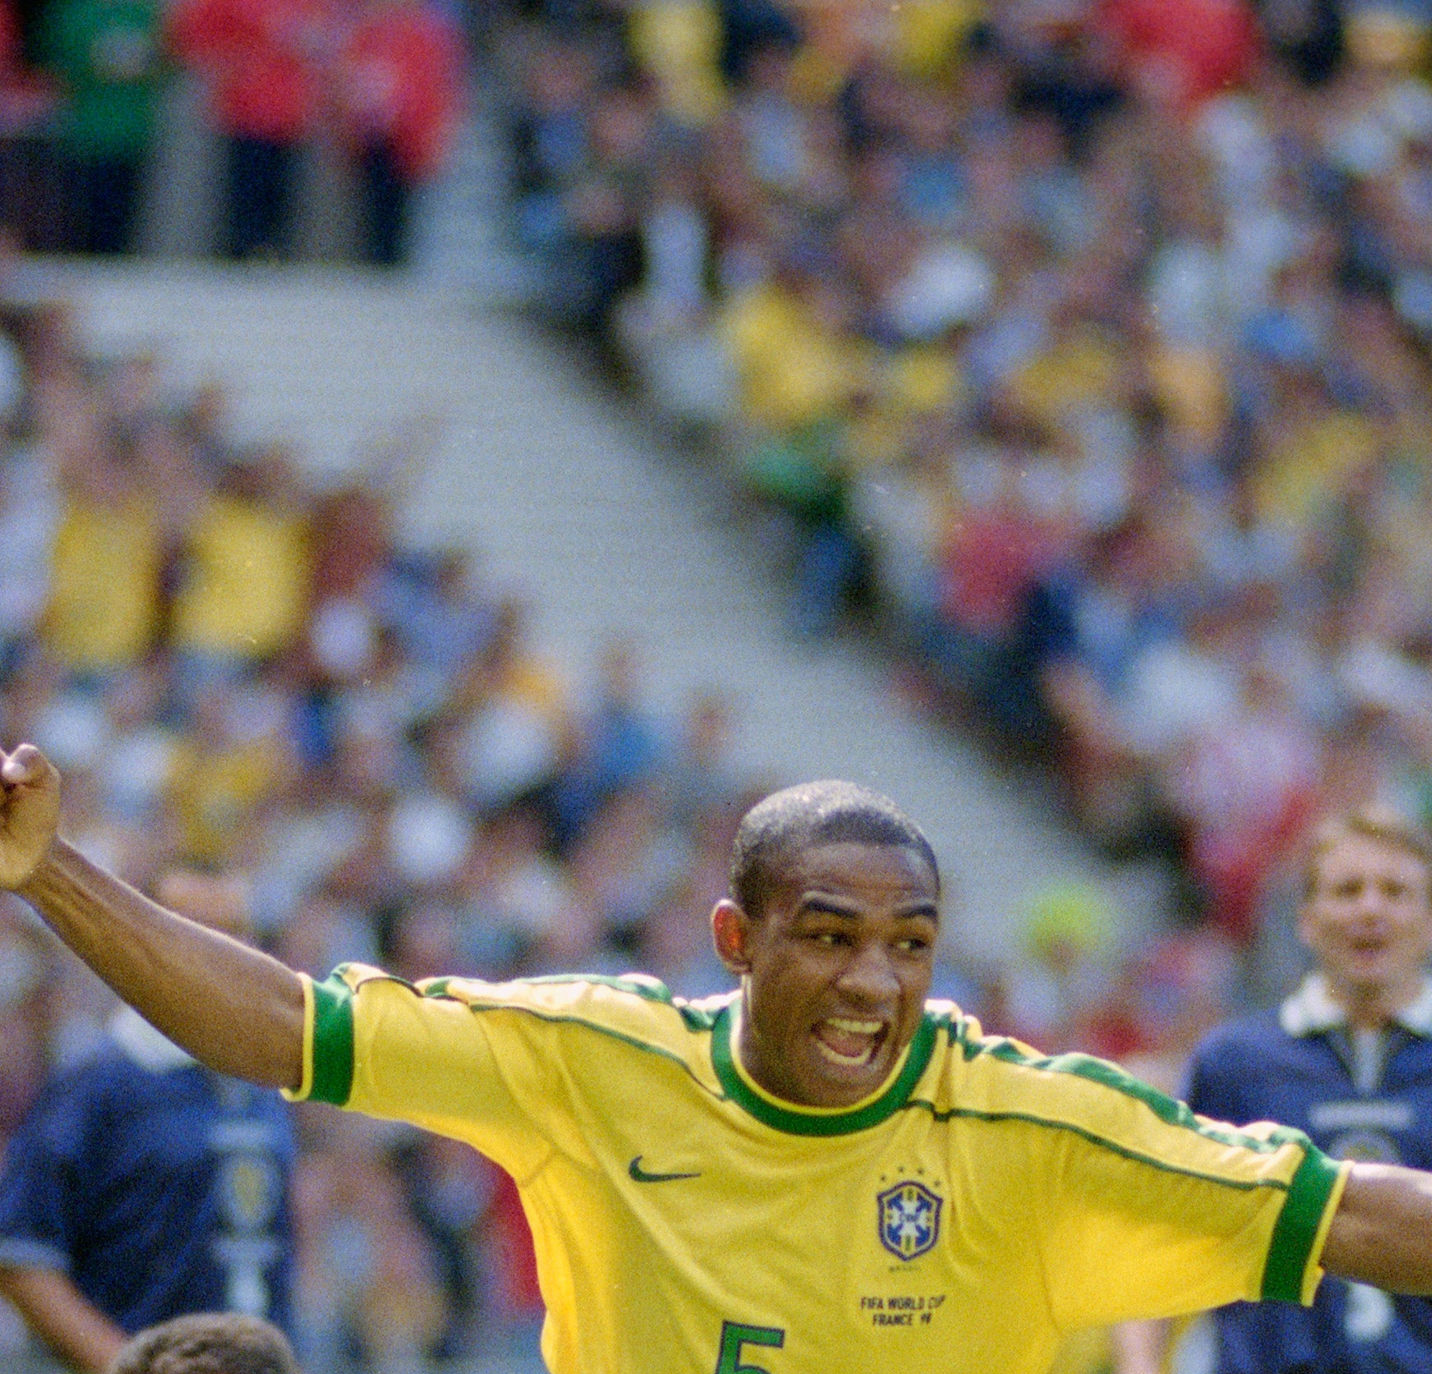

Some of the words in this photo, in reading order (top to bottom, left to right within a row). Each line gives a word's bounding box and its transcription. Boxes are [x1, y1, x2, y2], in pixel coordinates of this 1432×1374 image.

[860, 1296, 884, 1309] FIFA
[887, 1296, 925, 1310] WORLD
[872, 1313, 913, 1326] FRANCE
